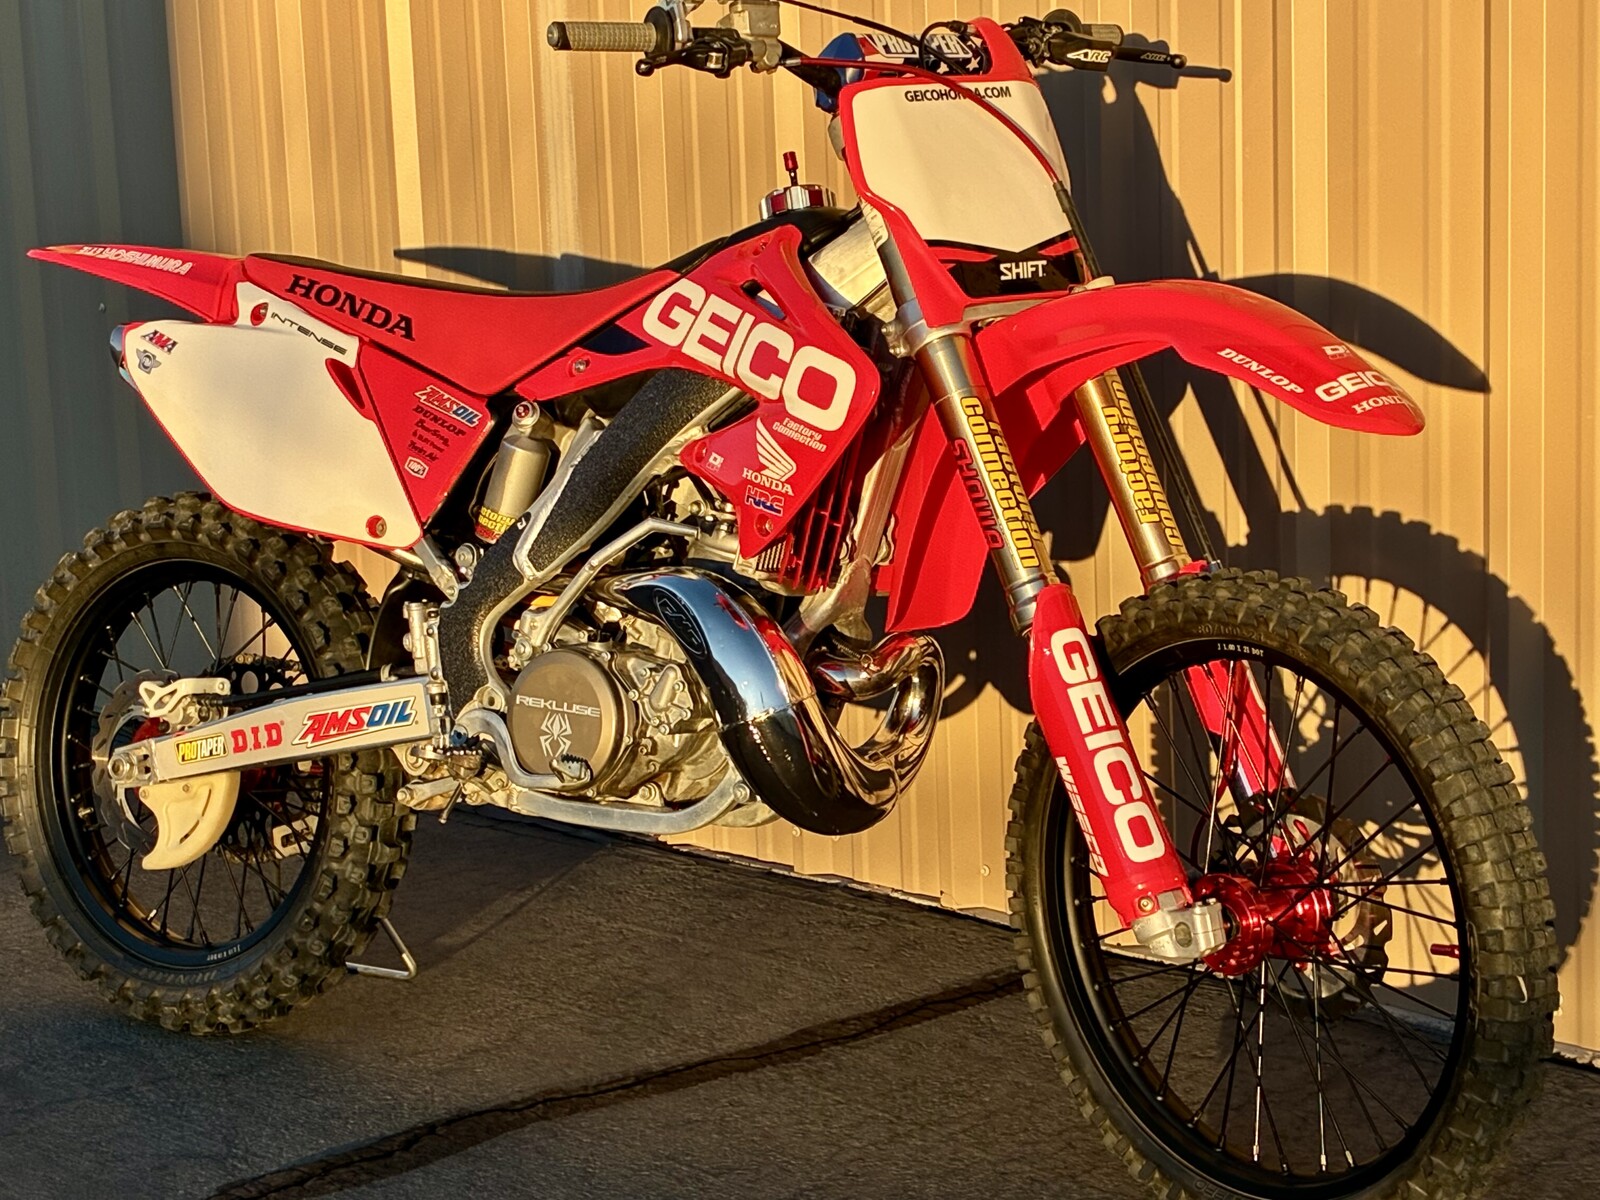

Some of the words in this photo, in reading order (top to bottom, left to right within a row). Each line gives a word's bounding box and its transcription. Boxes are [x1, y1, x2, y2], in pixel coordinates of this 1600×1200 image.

[868, 34, 966, 55] PROPER
[1067, 49, 1111, 62] ARC
[1000, 260, 1047, 280] SHIFT
[285, 274, 415, 341] HONDA
[271, 312, 347, 355] INTENSE
[642, 278, 857, 431] GEICO
[1217, 348, 1304, 394] DUNLOP
[1315, 371, 1398, 402] GEIC
[413, 404, 467, 436] DUNLOP
[416, 386, 481, 426] AMSOIL
[782, 418, 822, 440] Factory
[1102, 405, 1161, 525] Factory
[742, 467, 795, 496] HONDA
[745, 485, 784, 517] HRC
[299, 698, 415, 744] AMSOIL
[516, 694, 600, 718] REKLUSE
[177, 735, 225, 761] PROTAPER
[231, 723, 282, 754] D.I.D
[1051, 627, 1166, 863] GEICO
